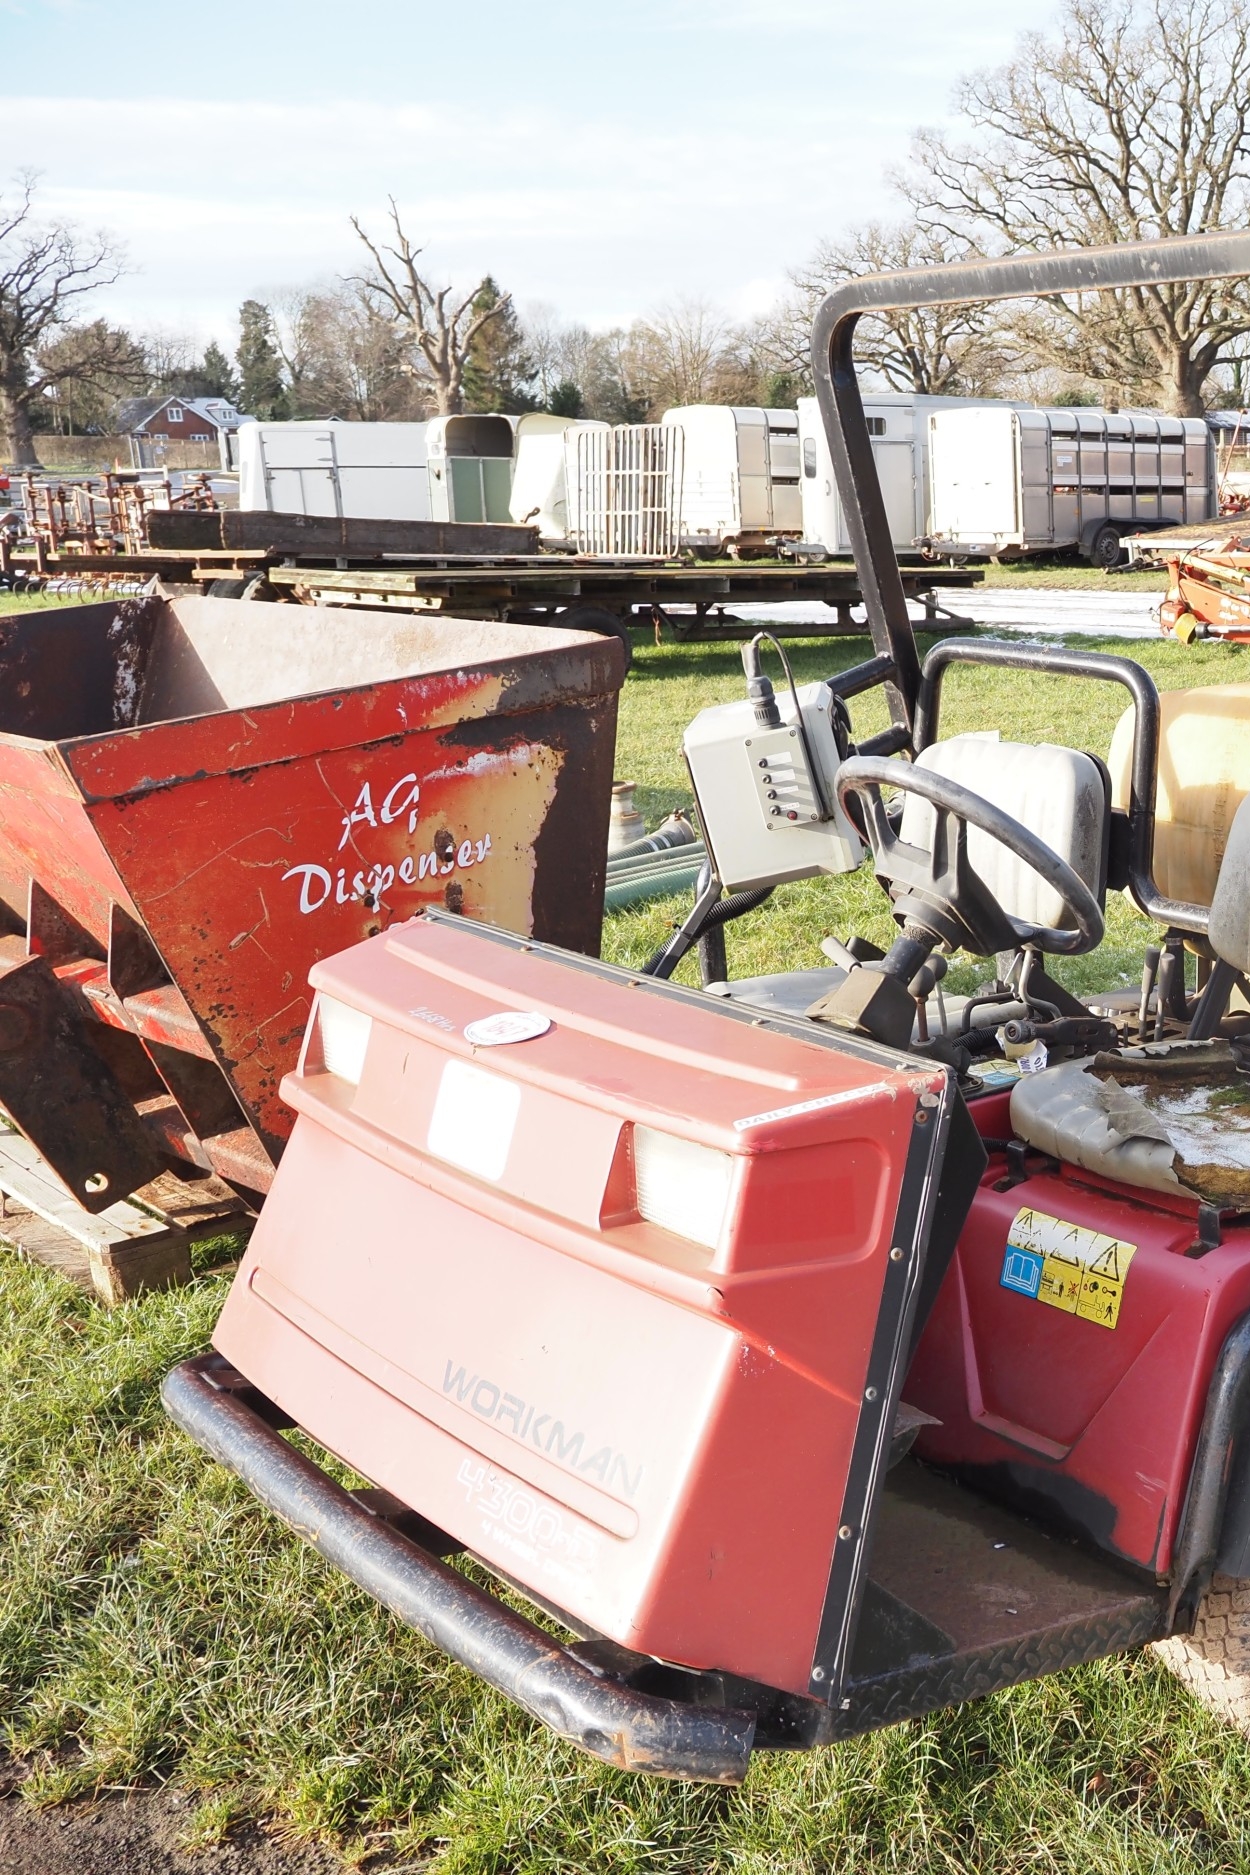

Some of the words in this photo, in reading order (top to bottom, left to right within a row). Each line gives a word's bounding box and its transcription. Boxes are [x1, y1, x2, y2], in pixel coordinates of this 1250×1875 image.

[338, 772, 420, 851] AG
[281, 832, 493, 915] Dispenser
[737, 1107, 793, 1128] DAILY
[441, 1359, 644, 1497] WORKMAN
